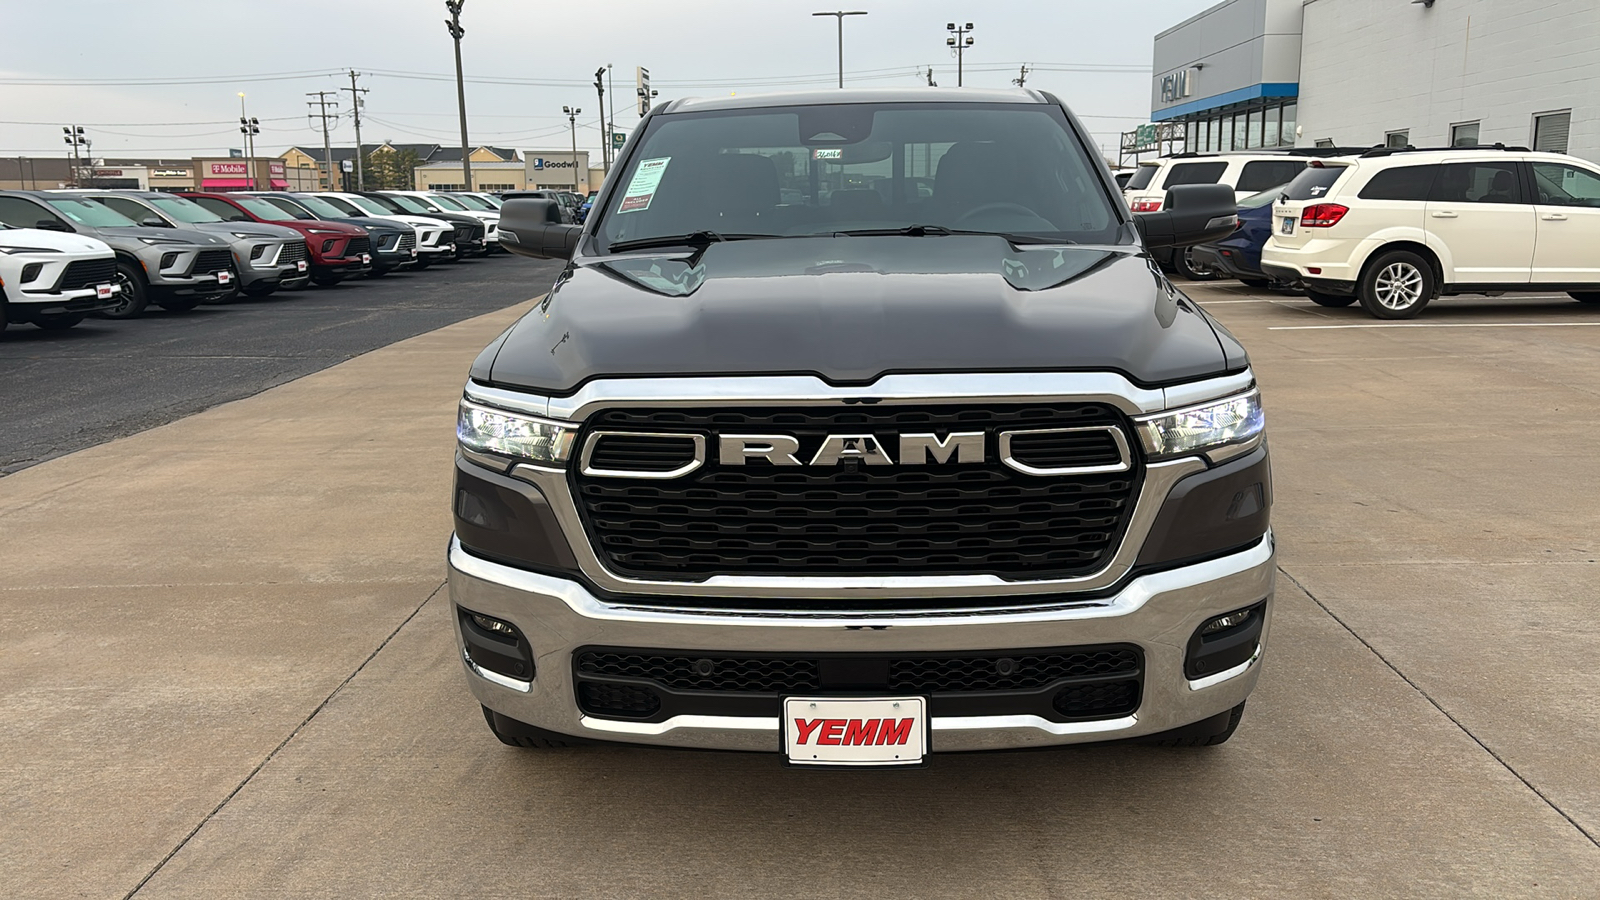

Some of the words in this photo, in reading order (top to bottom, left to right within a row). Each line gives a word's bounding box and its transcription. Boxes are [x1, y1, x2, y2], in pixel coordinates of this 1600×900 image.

[220, 165, 246, 173] Mobile
[544, 160, 579, 168] Goodwil
[719, 432, 985, 466] RAM
[794, 718, 915, 746] YEMM
